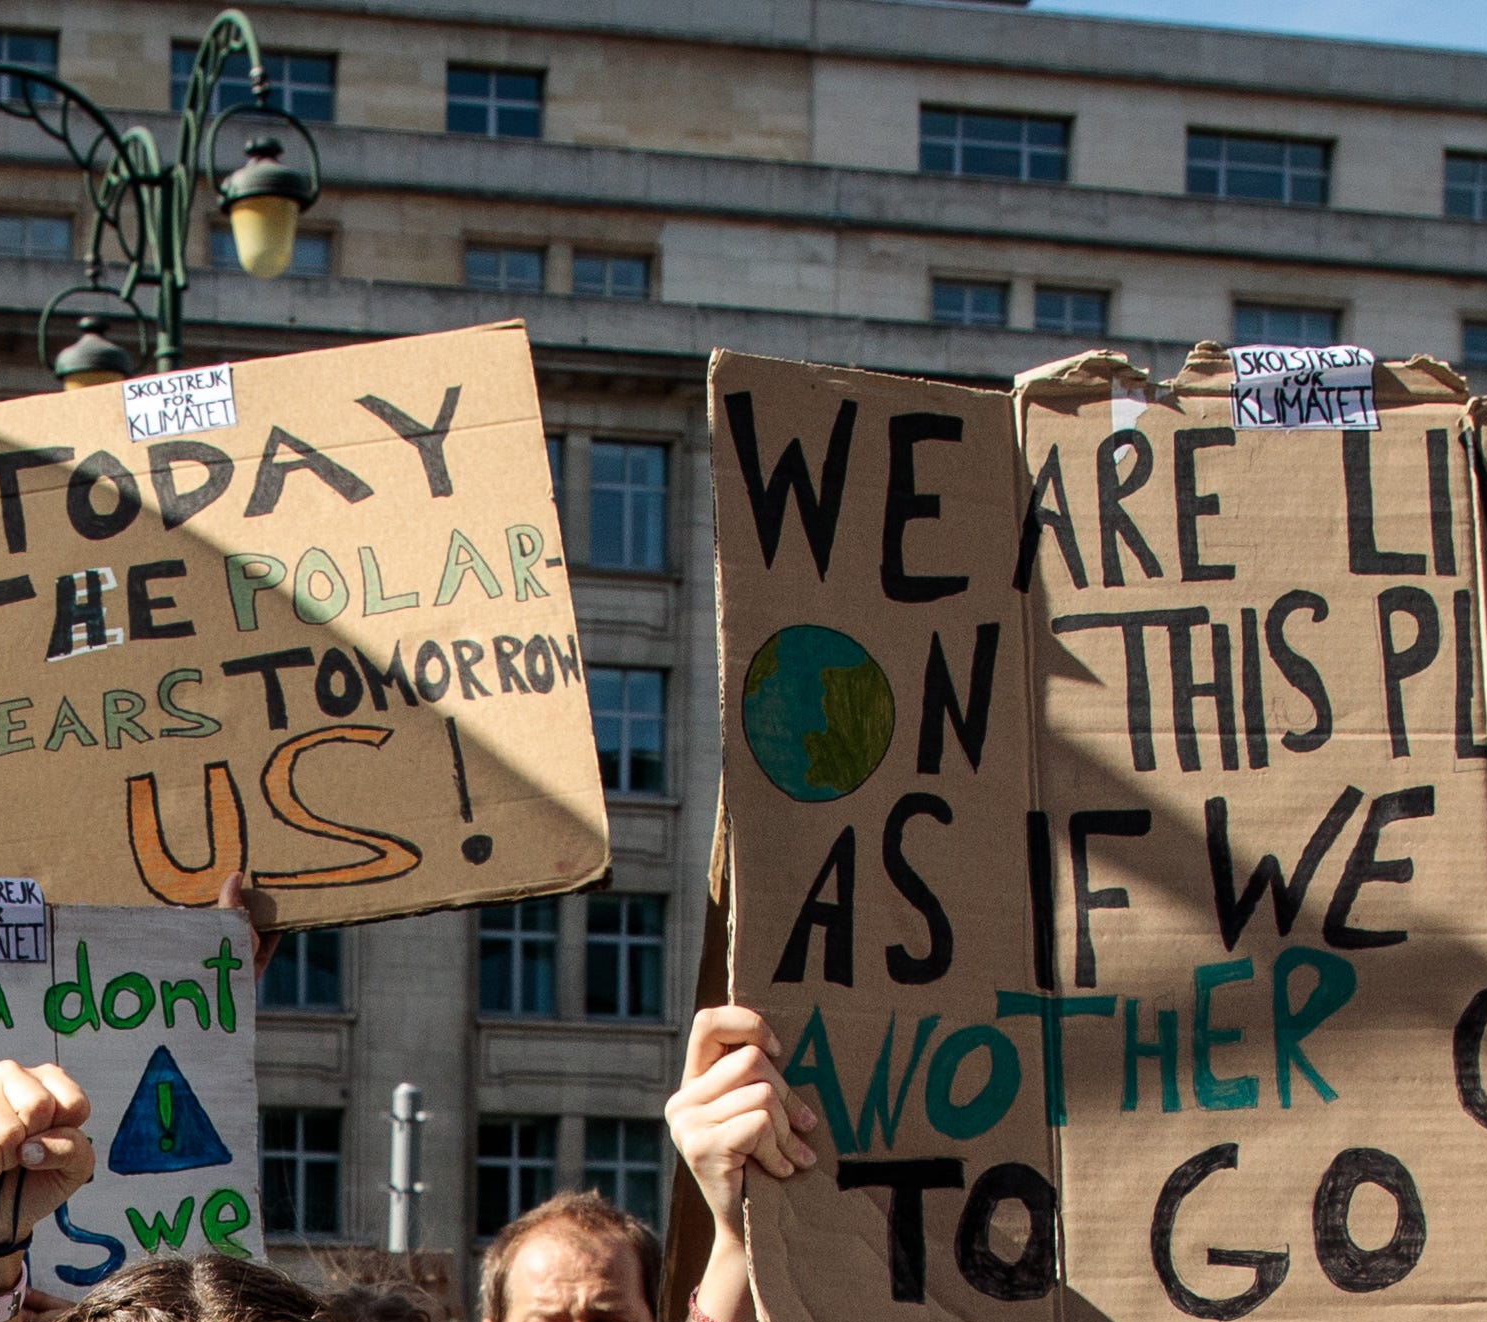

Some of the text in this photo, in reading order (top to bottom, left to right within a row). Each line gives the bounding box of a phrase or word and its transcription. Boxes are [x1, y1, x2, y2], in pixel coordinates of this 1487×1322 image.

[127, 369, 228, 401] SKOLSTREJK
[128, 398, 233, 439] KLIMATET
[163, 392, 194, 408] FÖR
[1234, 385, 1372, 425] KLIMATET
[721, 391, 969, 600] WE
[1012, 426, 1237, 594] ARE
[221, 633, 583, 731] TOMORROW
[1052, 588, 1334, 773] THIS
[771, 791, 954, 988] AS
[1029, 808, 1152, 992] IF
[1204, 784, 1436, 951] WE
[43, 936, 243, 1035] dont
[783, 946, 1357, 1155] ANOTHER
[126, 1187, 253, 1260] we
[837, 1158, 1060, 1305] TO
[1150, 1143, 1427, 1322] GO
